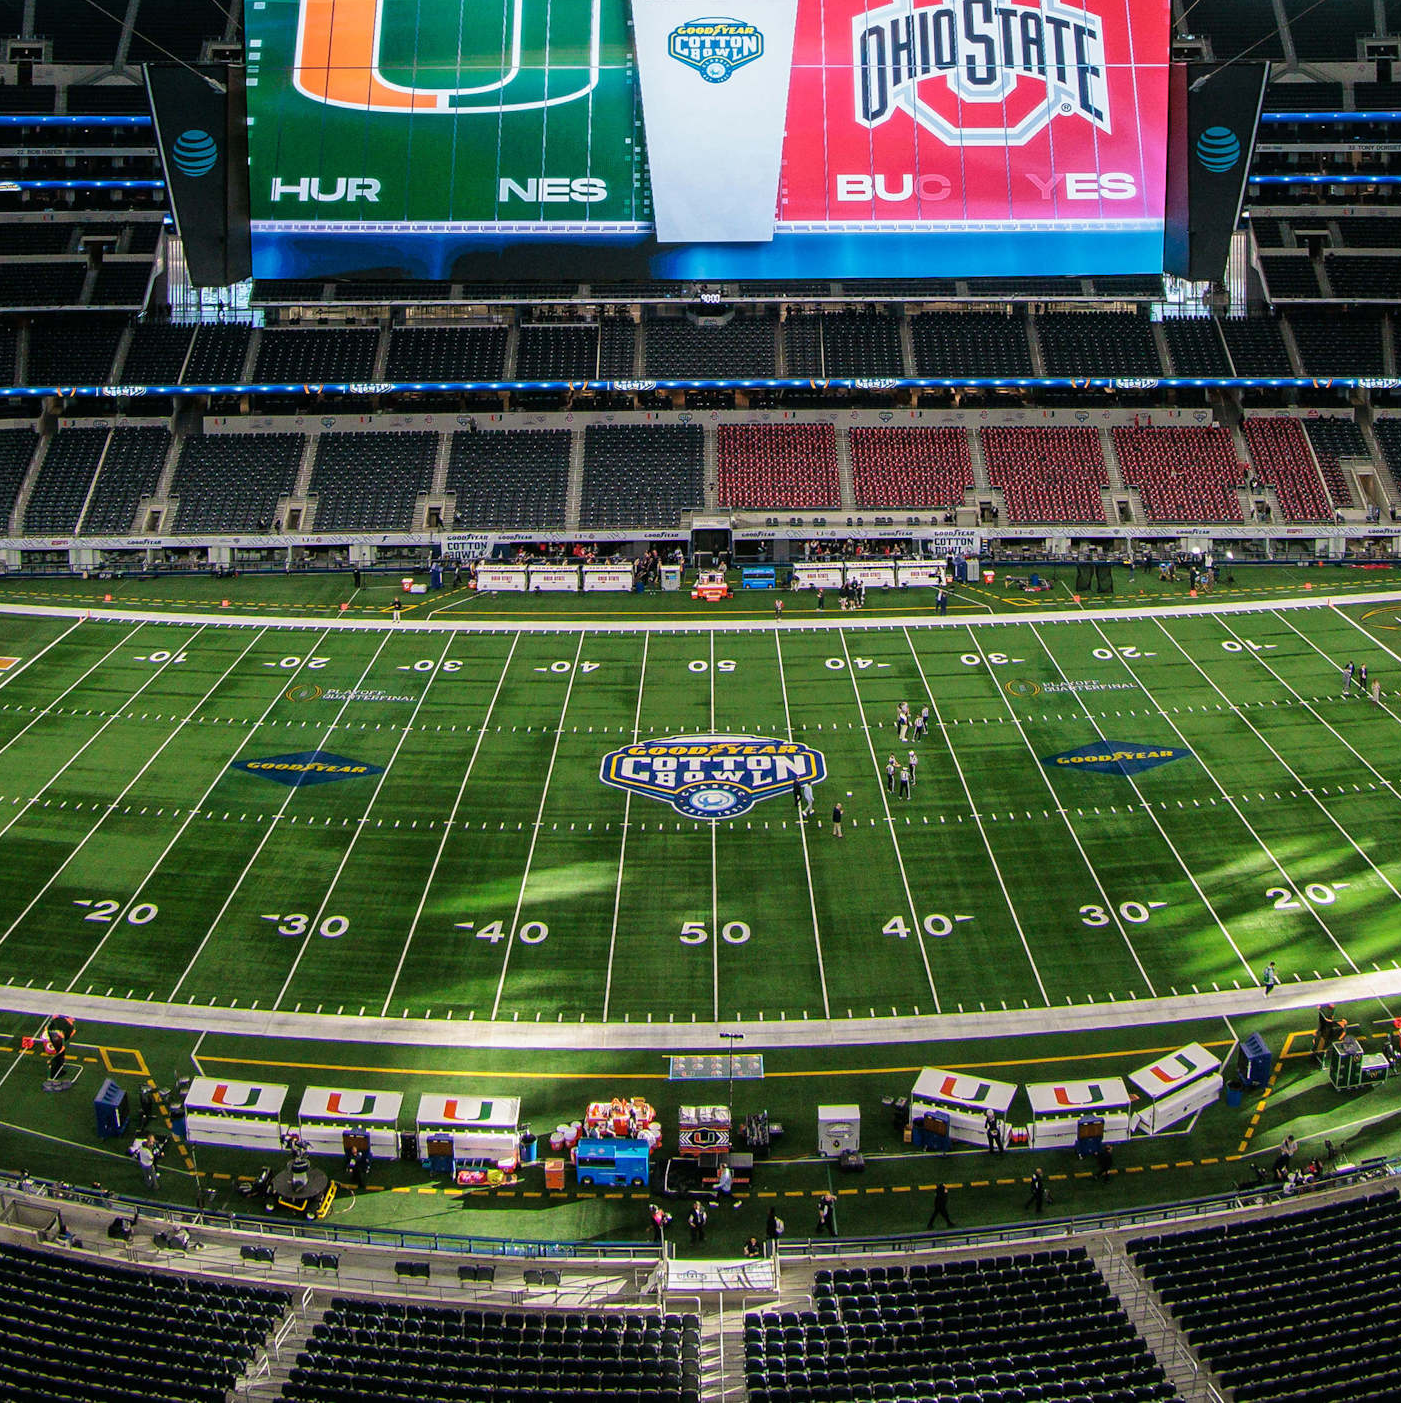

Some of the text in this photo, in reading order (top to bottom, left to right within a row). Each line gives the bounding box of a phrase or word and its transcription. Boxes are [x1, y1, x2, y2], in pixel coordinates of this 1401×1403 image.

[677, 24, 755, 37] GOODYEAR
[675, 35, 758, 55] COTTON
[690, 47, 744, 60] BOWL
[859, 8, 958, 123] OHIO
[271, 177, 608, 203] HUR NES
[701, 294, 720, 304] 90:00
[447, 533, 488, 541] GOODYEAR
[934, 538, 974, 546] COTTON
[447, 542, 487, 551] COTTON
[935, 546, 963, 554] BOWL
[448, 551, 480, 559] BOWL
[1092, 645, 1144, 660] 20
[1221, 640, 1263, 653] 10
[279, 656, 331, 670] 20
[412, 659, 465, 672] 30
[687, 659, 738, 673] 50
[824, 656, 877, 670] 40
[960, 652, 1012, 666] 30
[549, 659, 601, 674] 40
[1044, 683, 1138, 693] QUARTERFINAL
[628, 743, 801, 757] GOODYEAR
[1056, 750, 1174, 765] GOODYEAR
[247, 762, 368, 774] GOODYEAR
[620, 755, 807, 781] COTTON
[654, 770, 773, 788] BOWL
[681, 783, 746, 797] CLASSIC
[1265, 881, 1337, 912] 20
[84, 899, 159, 925] 20
[1078, 900, 1152, 928] 30
[278, 913, 350, 939] 30
[474, 919, 550, 946] 40
[679, 920, 752, 946] 50
[881, 913, 955, 940] 40
